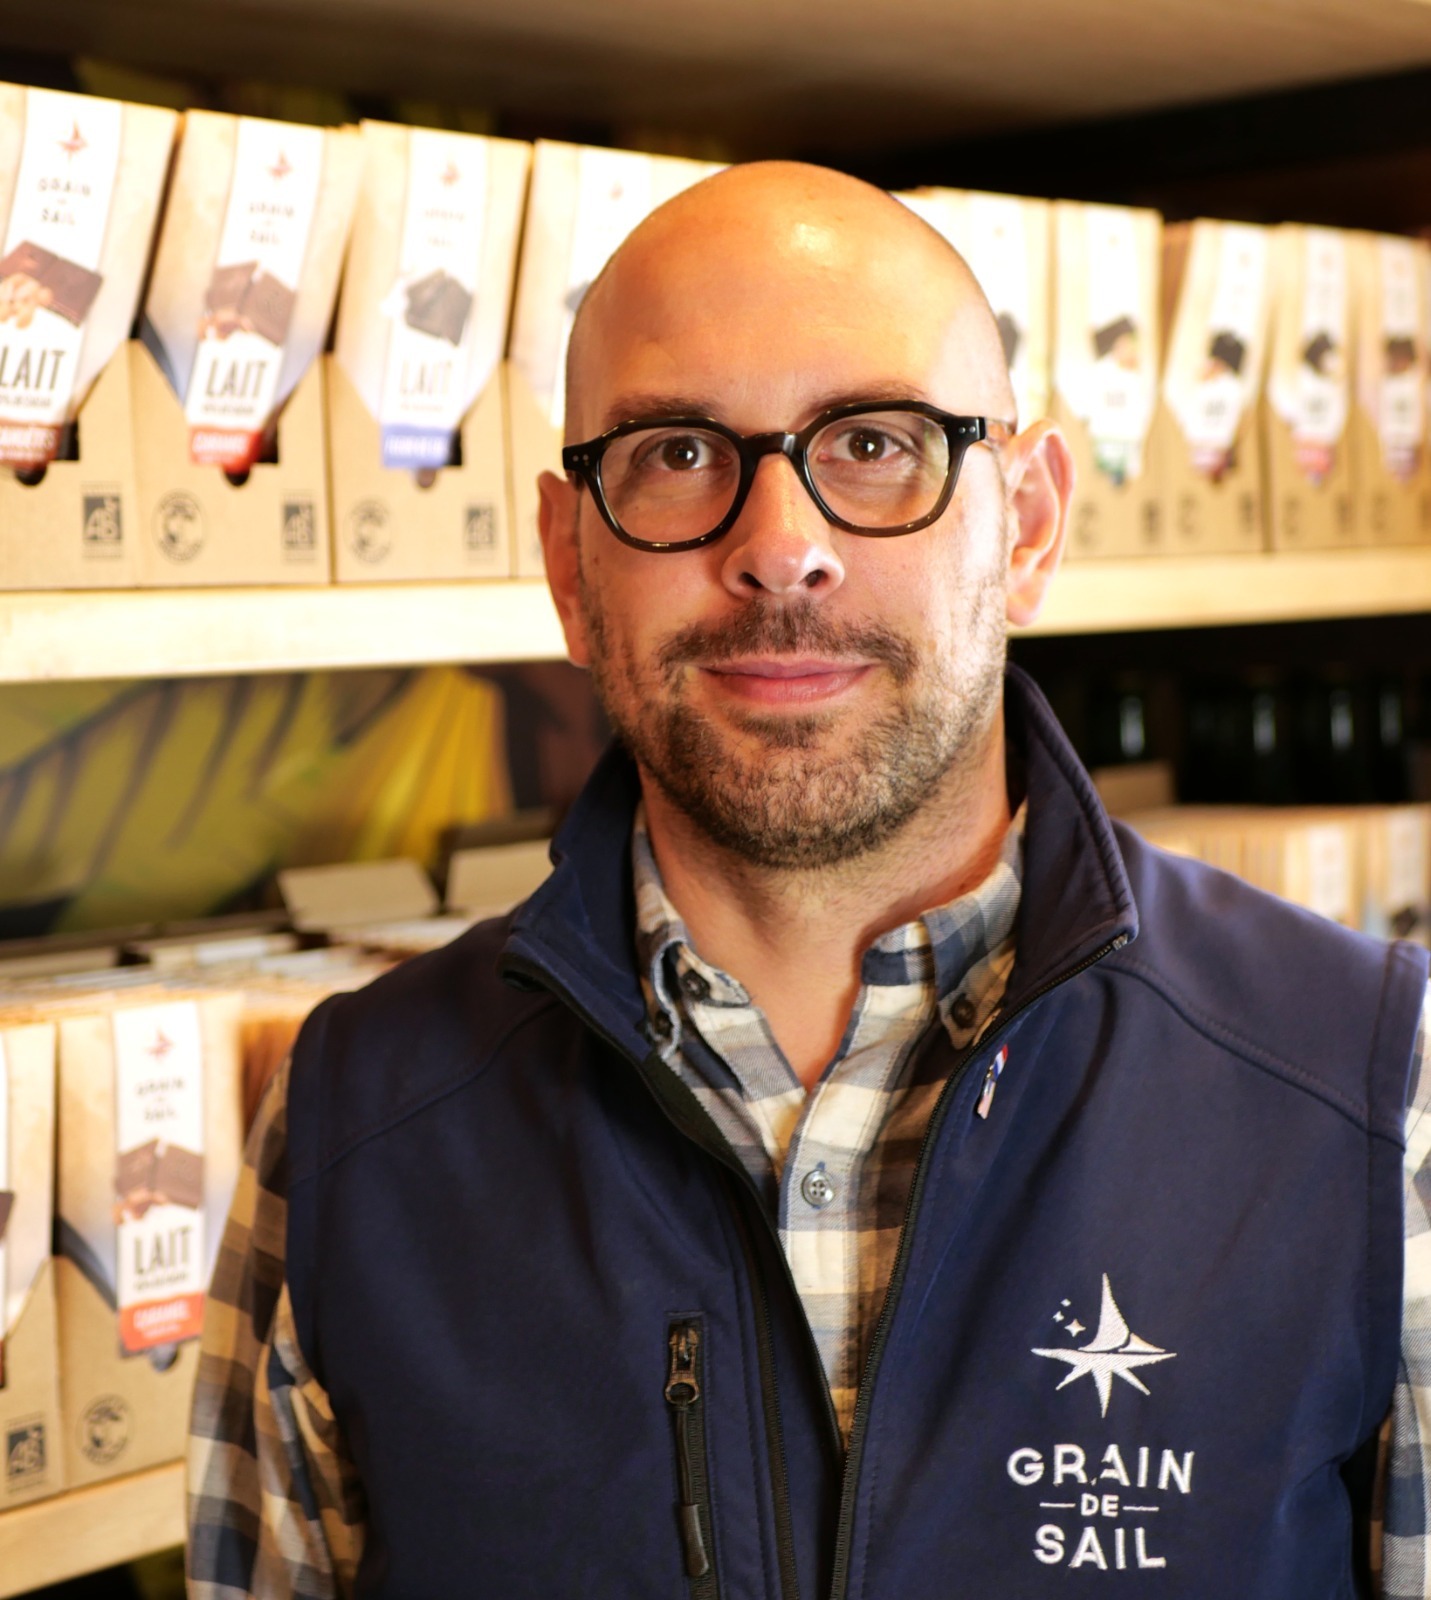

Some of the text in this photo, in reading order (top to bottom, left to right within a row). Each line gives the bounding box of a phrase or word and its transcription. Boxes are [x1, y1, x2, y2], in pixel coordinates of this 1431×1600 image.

[0, 345, 66, 390] LAIT
[205, 358, 267, 398] LAIT
[134, 1225, 192, 1274] LAIT
[1007, 1443, 1195, 1493] GRAIN
[1080, 1493, 1119, 1517] DE
[1033, 1524, 1166, 1570] SAIL
